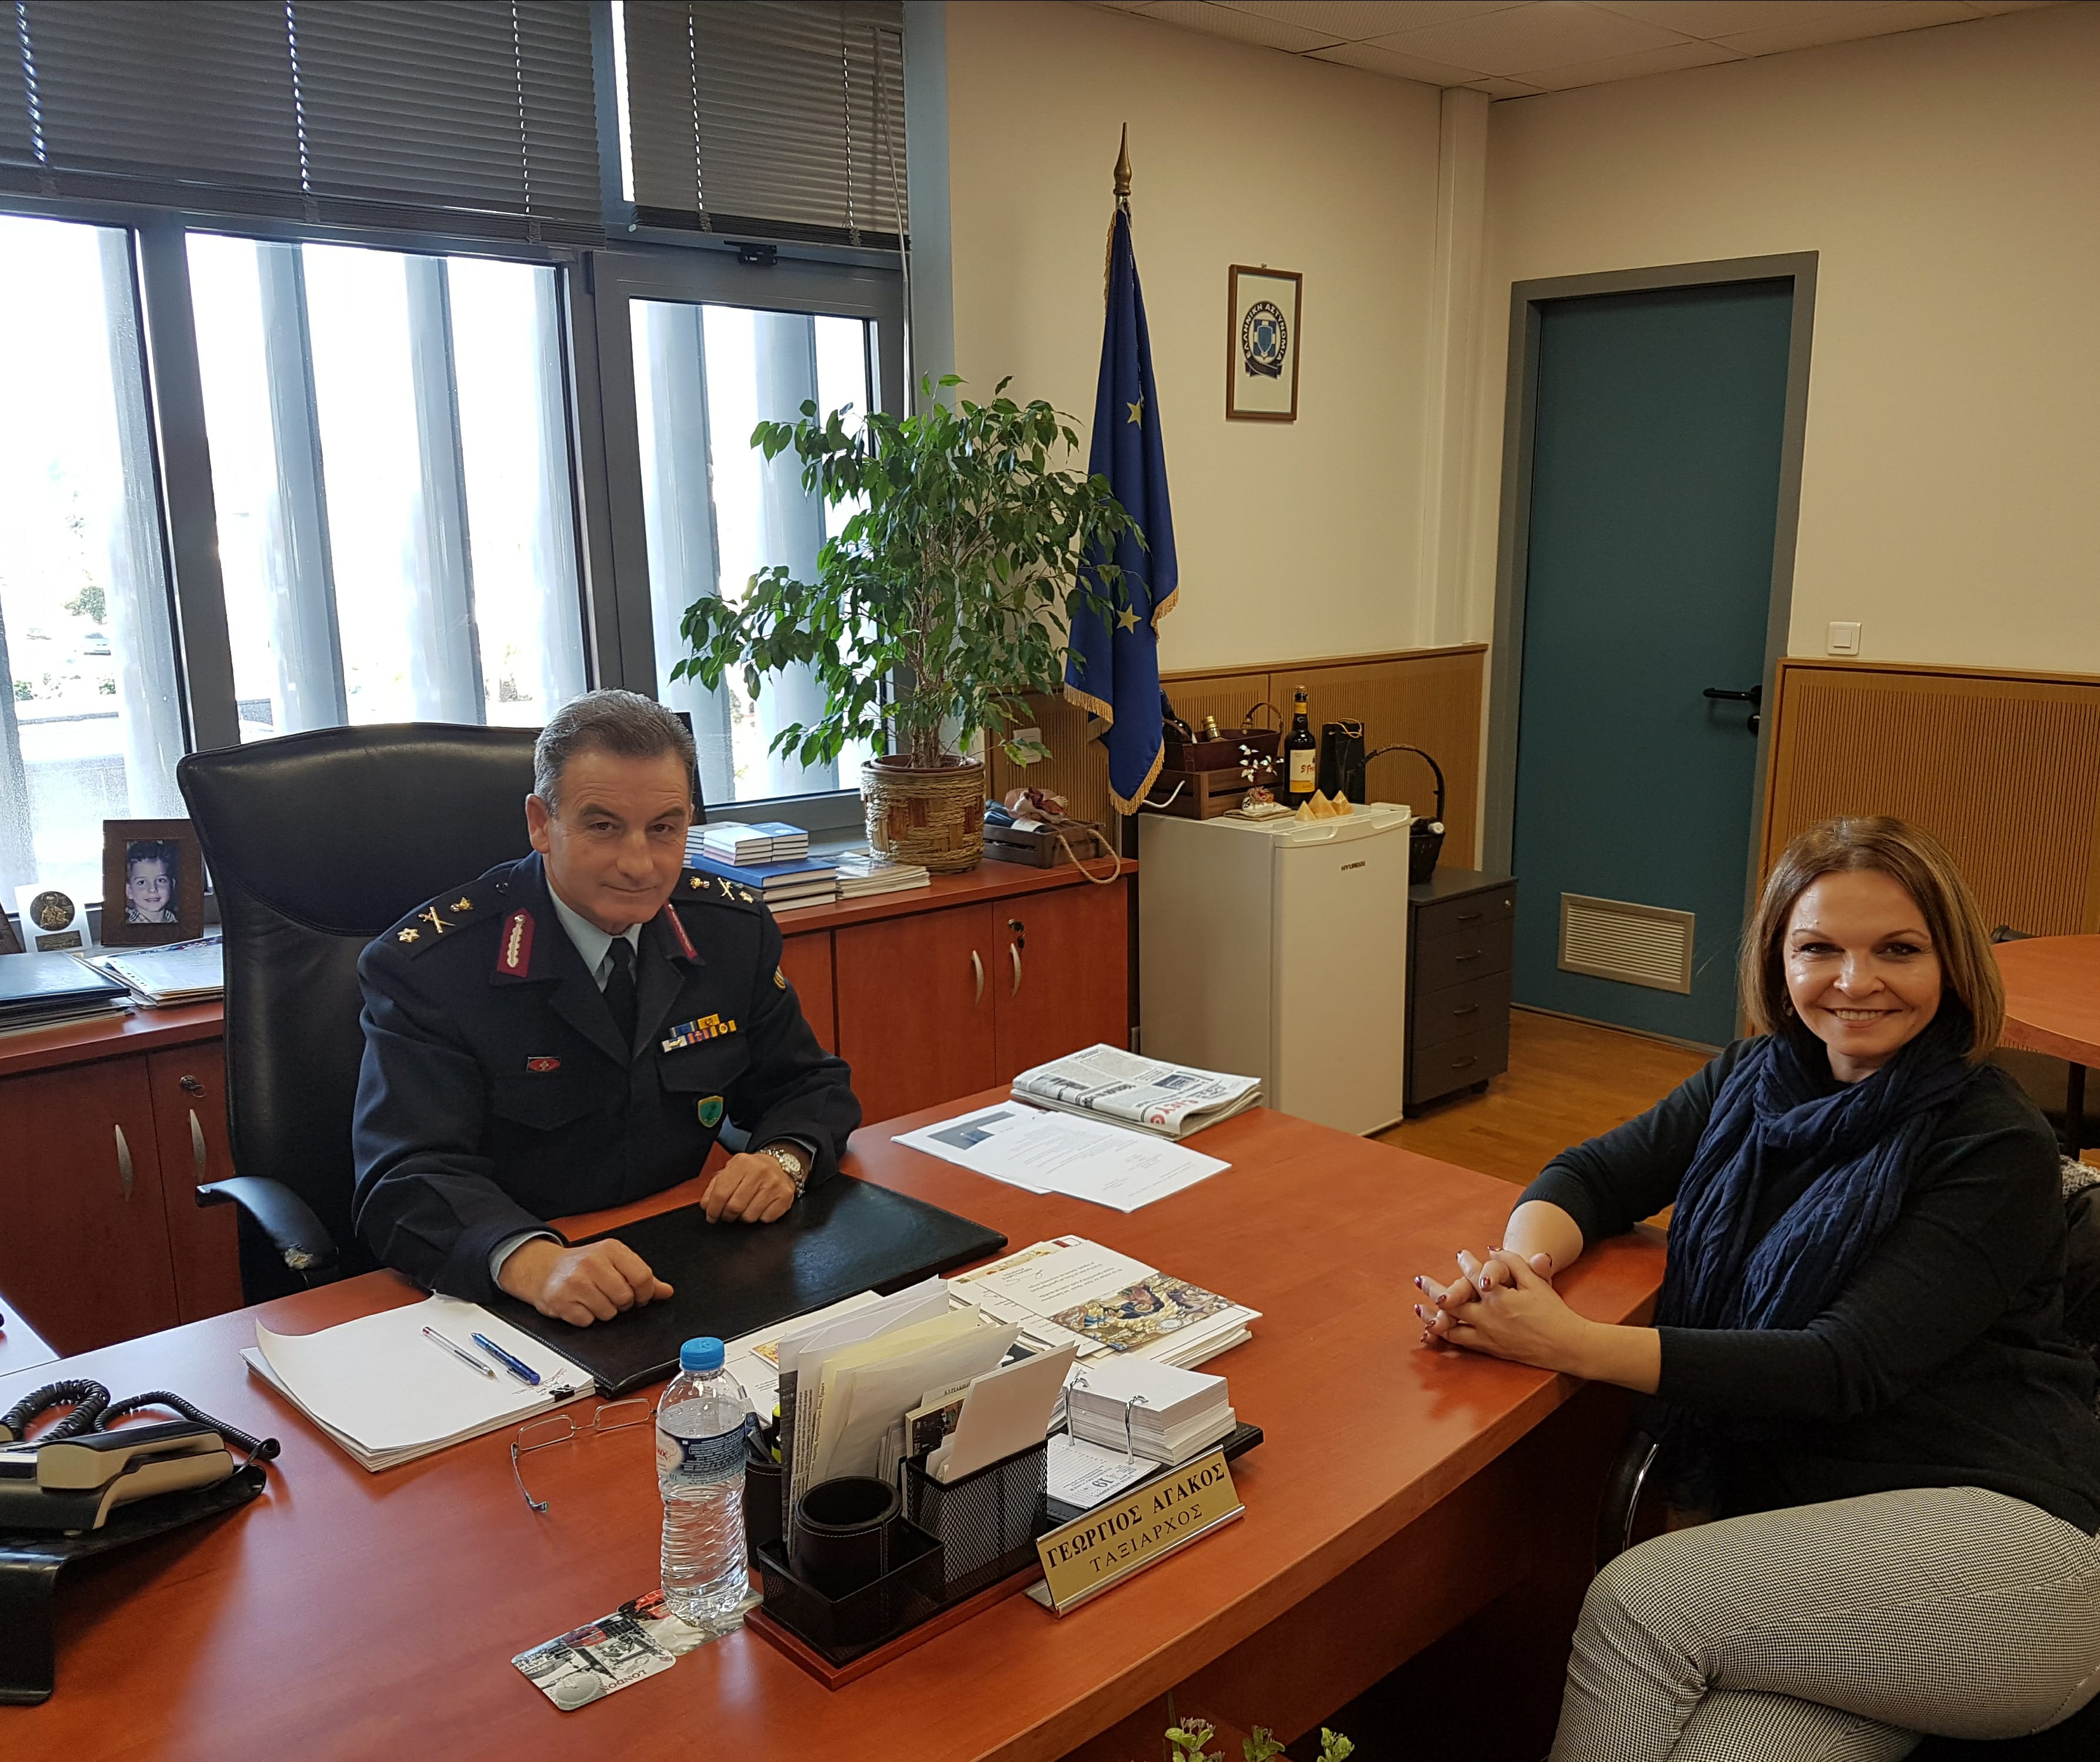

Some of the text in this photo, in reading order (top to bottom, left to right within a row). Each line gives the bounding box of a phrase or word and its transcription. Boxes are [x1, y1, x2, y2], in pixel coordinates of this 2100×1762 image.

[1243, 303, 1286, 360] ΕΛΛΗΝΙΚΗ ΑΣΤΥΝΟΜΙΑ
[1092, 1477, 1114, 1487] 19
[1046, 1506, 1143, 1568] ΓΕΩΡΓΙΟΣ
[1152, 1463, 1225, 1514] ΑΓΑΚΟΣ
[1090, 1504, 1203, 1572] ΤΑΞΙΑΡΧΟΣ
[600, 1669, 648, 1693] LONDON
